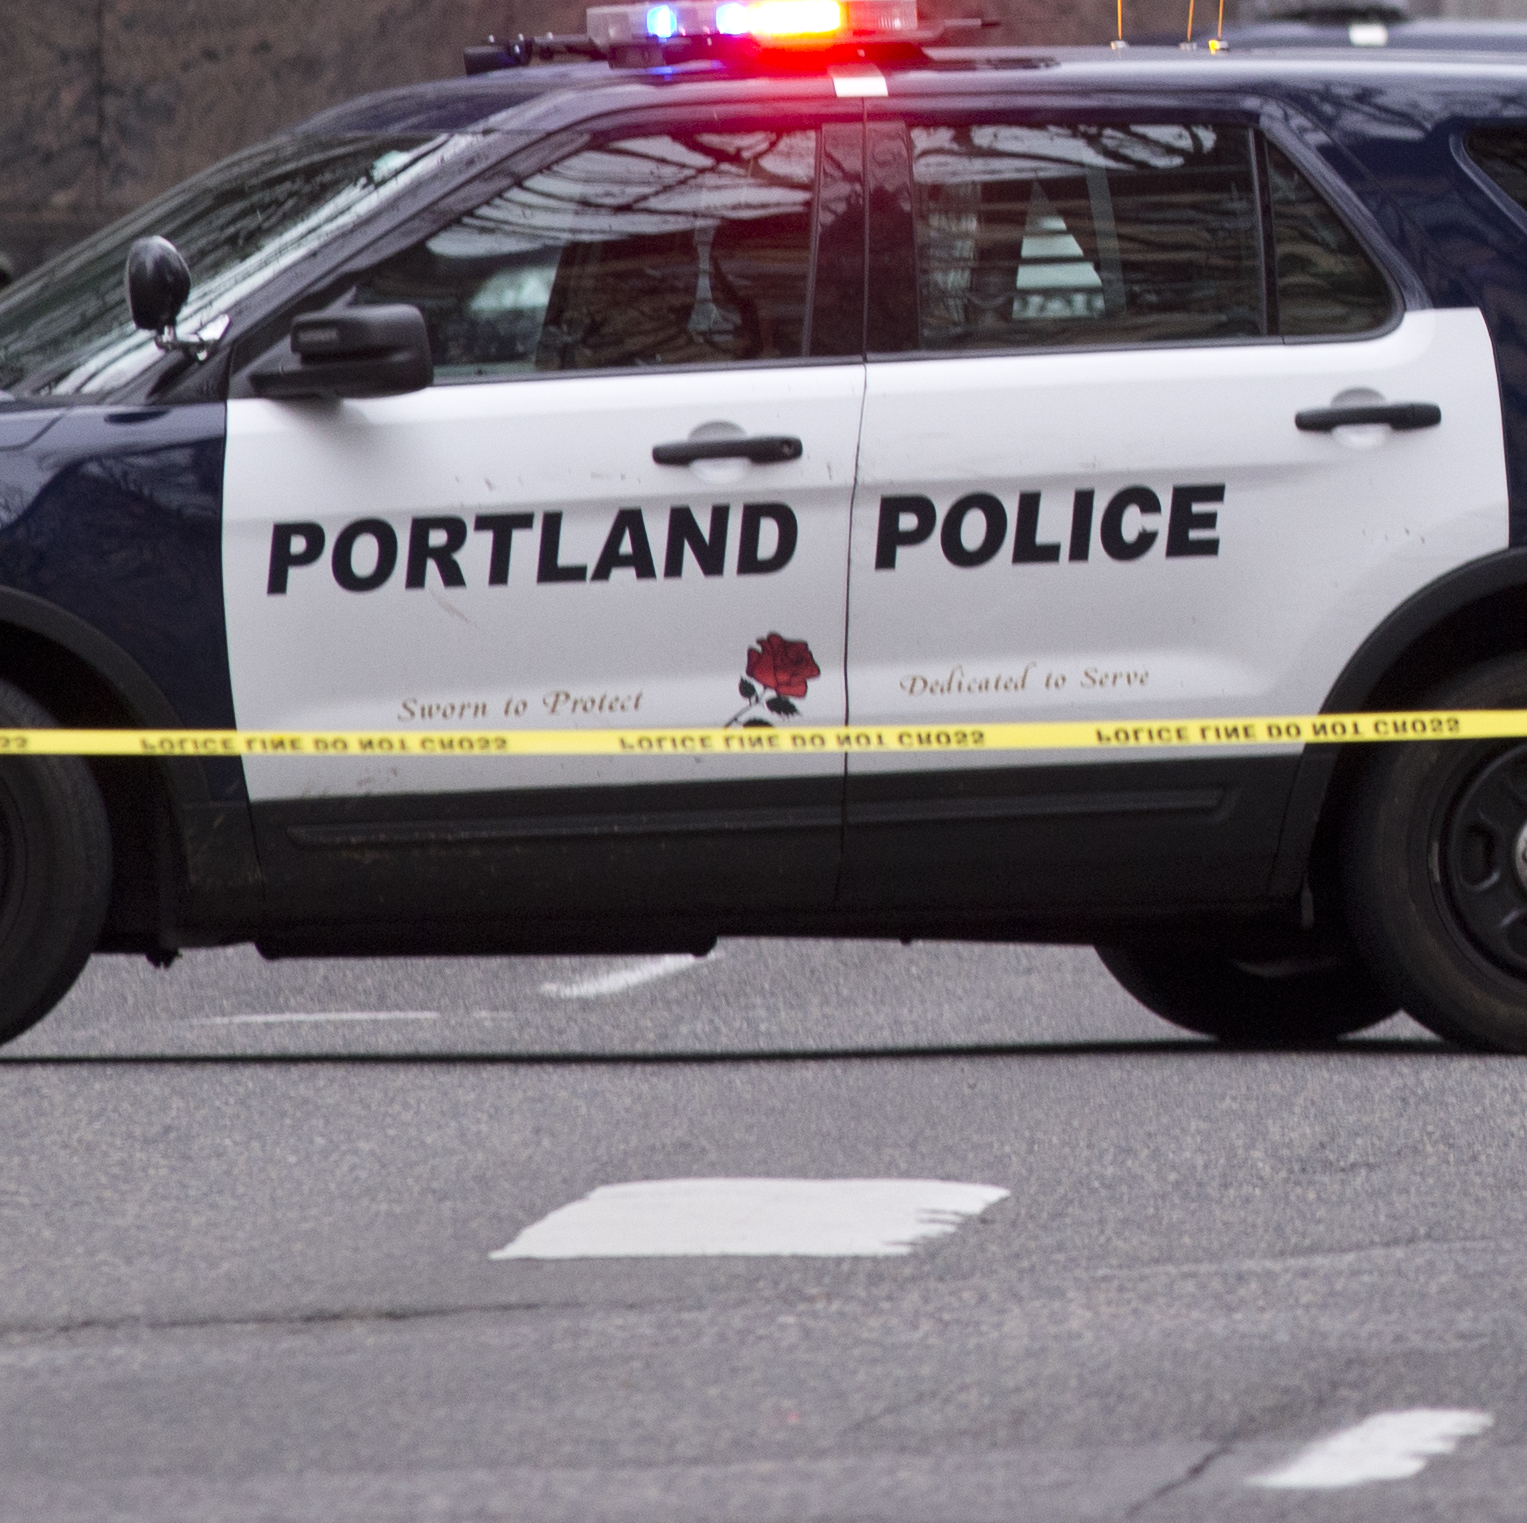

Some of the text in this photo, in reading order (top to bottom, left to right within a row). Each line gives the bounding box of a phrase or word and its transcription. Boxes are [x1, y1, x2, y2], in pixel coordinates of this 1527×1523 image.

[266, 502, 799, 596] PORTLAND
[874, 483, 1226, 570] POLICE
[398, 690, 644, 722] Sworn to Protect
[901, 661, 1150, 696] Dedicated to Serve
